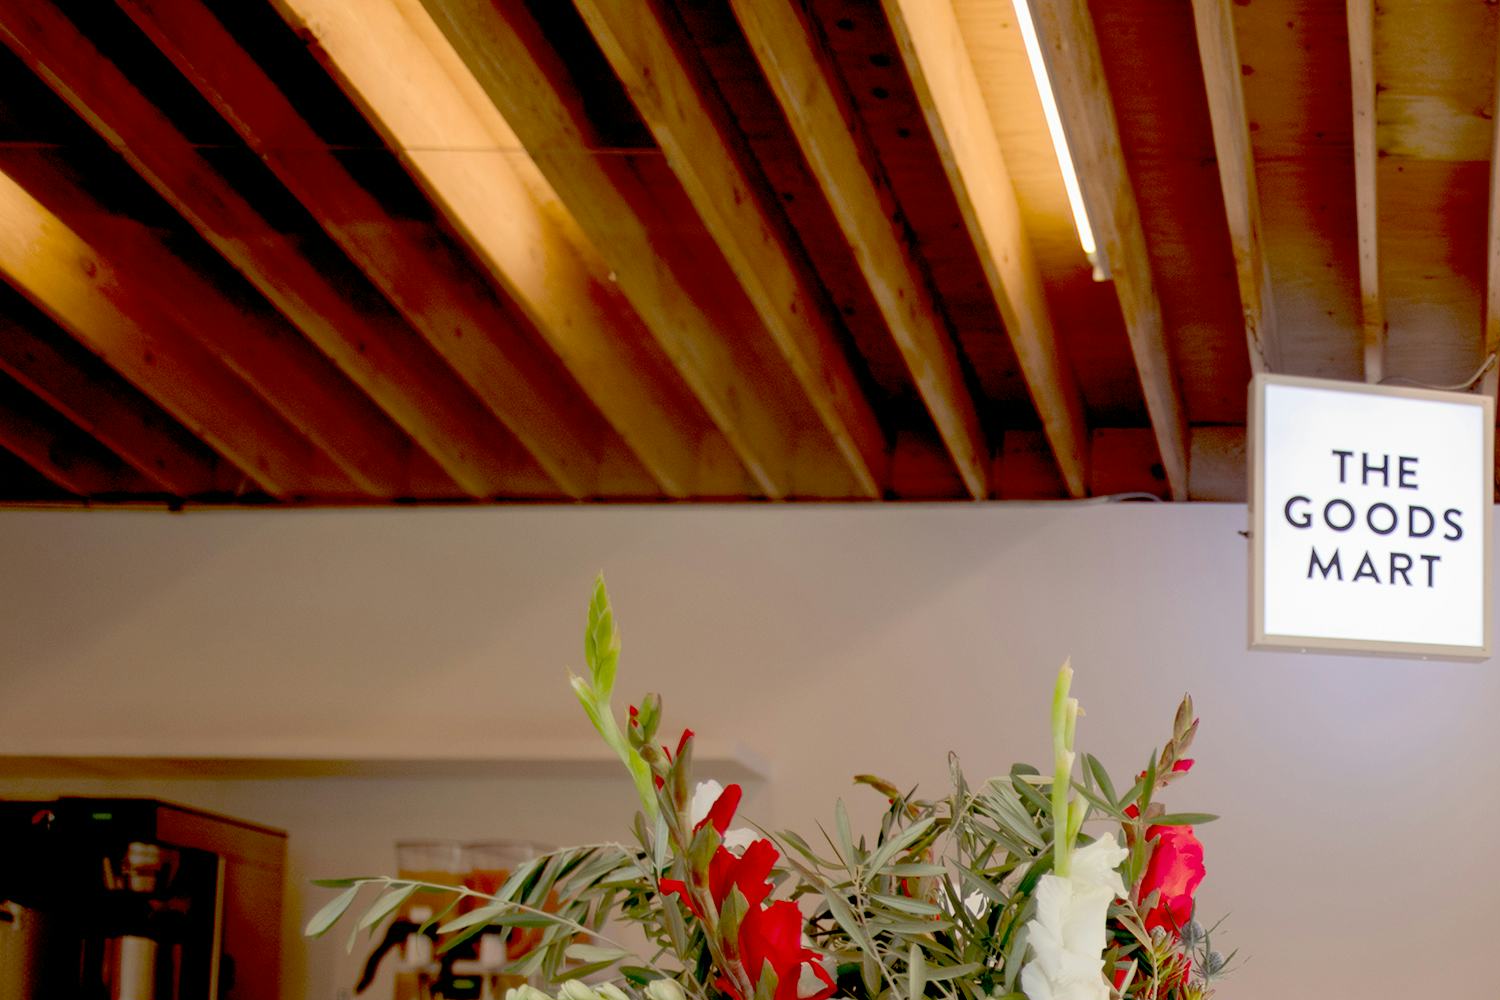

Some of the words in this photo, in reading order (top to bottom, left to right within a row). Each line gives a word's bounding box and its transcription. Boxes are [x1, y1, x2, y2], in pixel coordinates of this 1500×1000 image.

[1331, 449, 1419, 490] THE
[1283, 495, 1464, 542] GOODS
[1306, 546, 1442, 588] MART
